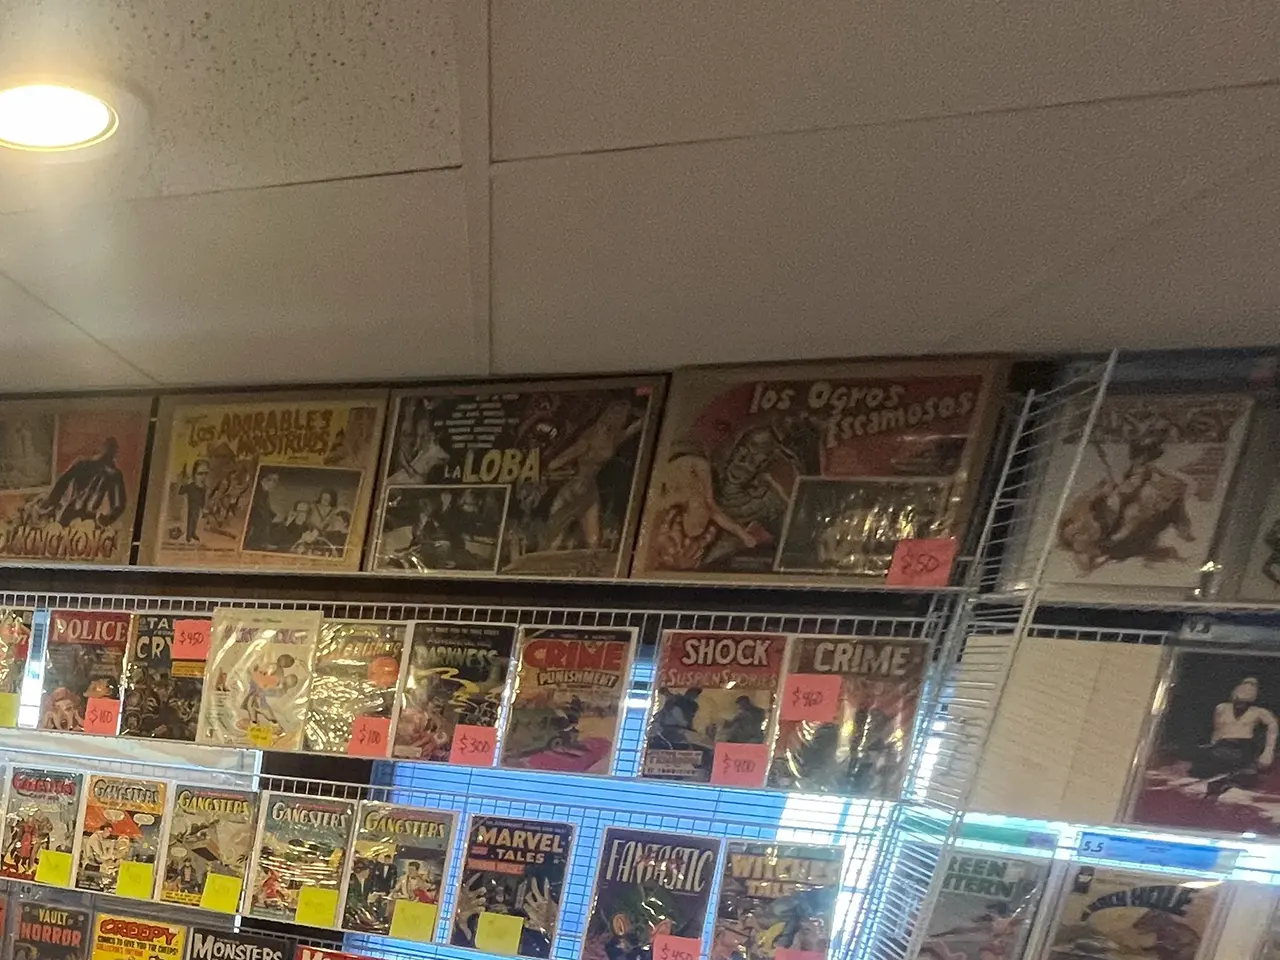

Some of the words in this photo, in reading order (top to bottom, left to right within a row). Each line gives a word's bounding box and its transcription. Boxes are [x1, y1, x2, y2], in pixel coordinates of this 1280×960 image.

[806, 381, 907, 410] Ogros
[221, 408, 334, 442] ADORABLES
[823, 389, 975, 448] Escamosos
[461, 446, 542, 484] LOBA
[63, 525, 118, 558] KONG
[52, 617, 129, 643] POLICE
[178, 631, 206, 645] $450
[523, 639, 624, 671] CRIME
[681, 637, 772, 666] SHOCK
[813, 641, 912, 677] CRIME
[538, 671, 620, 689] PUNISHMENT
[93, 778, 161, 804] GANGSTERS
[177, 789, 251, 816] GANGSTERS
[271, 801, 349, 829] GANGSTERS
[365, 811, 446, 839] GANGSTERS
[476, 825, 564, 854] MARVEL
[1082, 840, 1103, 852] 5.5
[495, 848, 546, 865] TALES
[605, 838, 714, 894] FANTASTIC
[947, 856, 1009, 878] REEN
[38, 908, 69, 924] VAULT
[20, 922, 82, 948] HORROR
[100, 918, 177, 946] CREEPY
